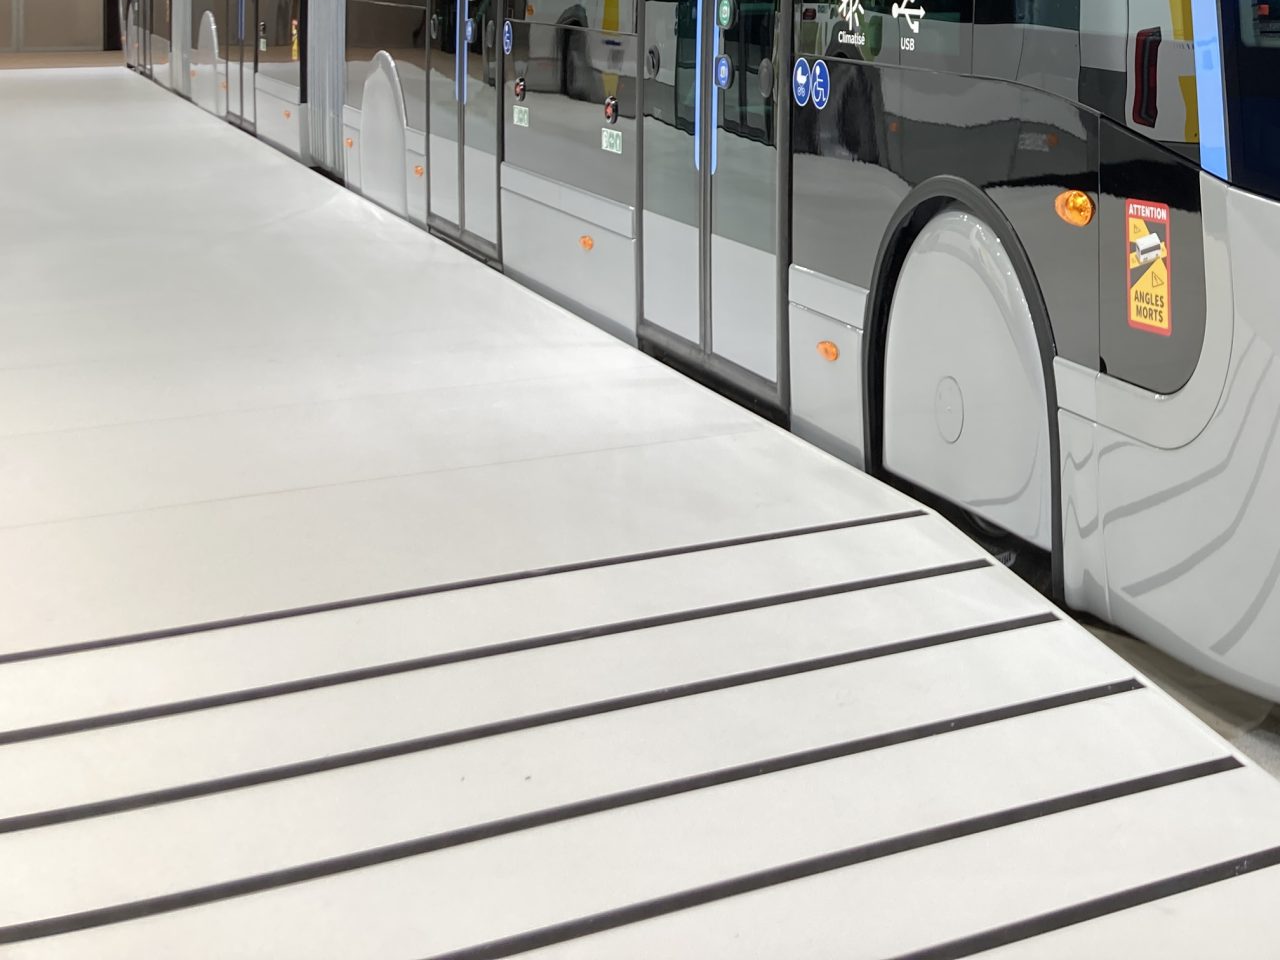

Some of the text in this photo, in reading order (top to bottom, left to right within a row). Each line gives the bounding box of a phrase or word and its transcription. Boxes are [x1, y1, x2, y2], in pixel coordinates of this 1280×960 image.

[838, 31, 866, 45] Climatisé
[900, 37, 915, 51] USB
[1129, 203, 1167, 221] ATTENTION
[1134, 290, 1165, 308] ANGLES
[1135, 303, 1164, 323] MORTS
